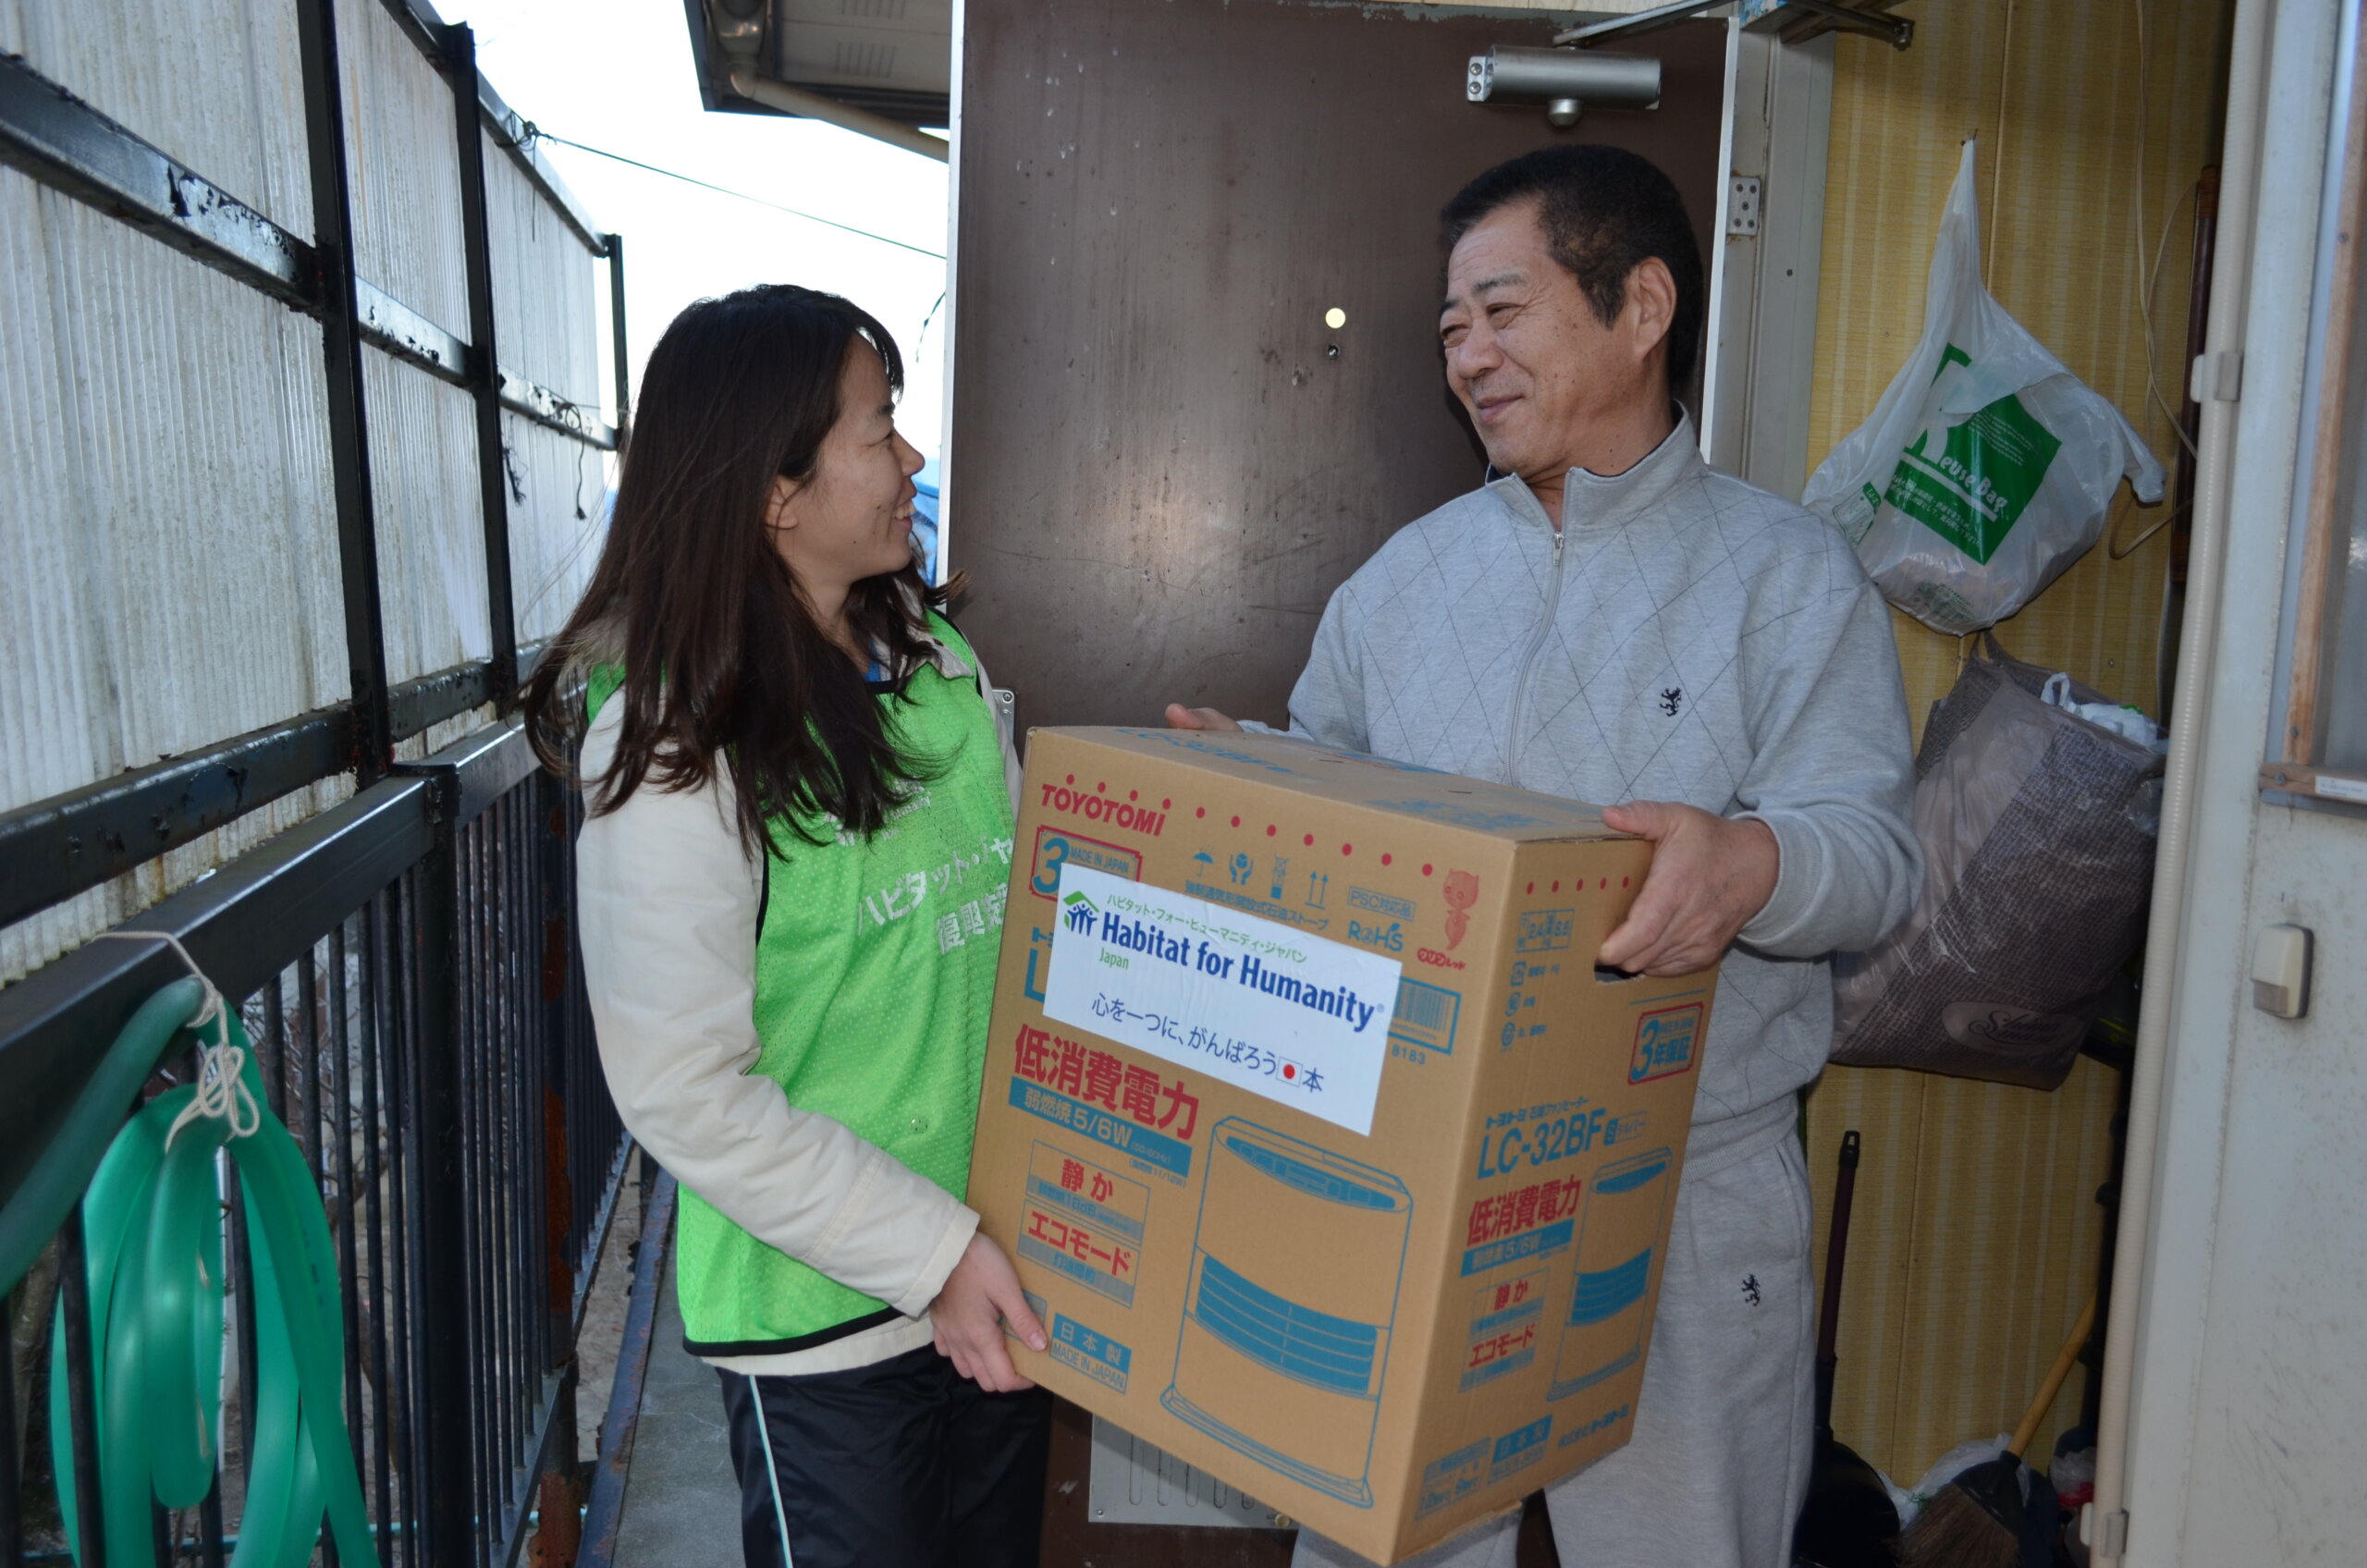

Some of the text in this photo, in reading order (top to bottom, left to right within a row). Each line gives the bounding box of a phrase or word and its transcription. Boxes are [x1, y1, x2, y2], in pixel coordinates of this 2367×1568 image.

[1041, 783, 1166, 836] TOYOTOMI
[1071, 847, 1093, 864] MADE
[1095, 853, 1102, 866] IN
[1104, 857, 1129, 875] JAPAN
[1099, 947, 1129, 970] Japan
[1102, 912, 1375, 1033] Habitat for Humanity
[1014, 1023, 1199, 1140] 低消費電力
[1477, 1108, 1607, 1180] LC-32BF
[1467, 1174, 1581, 1246] 低消費電力
[1028, 1211, 1131, 1276] エコモード
[1053, 1344, 1124, 1387] MADE IN JAPAN
[1469, 1323, 1535, 1367] エコモード
